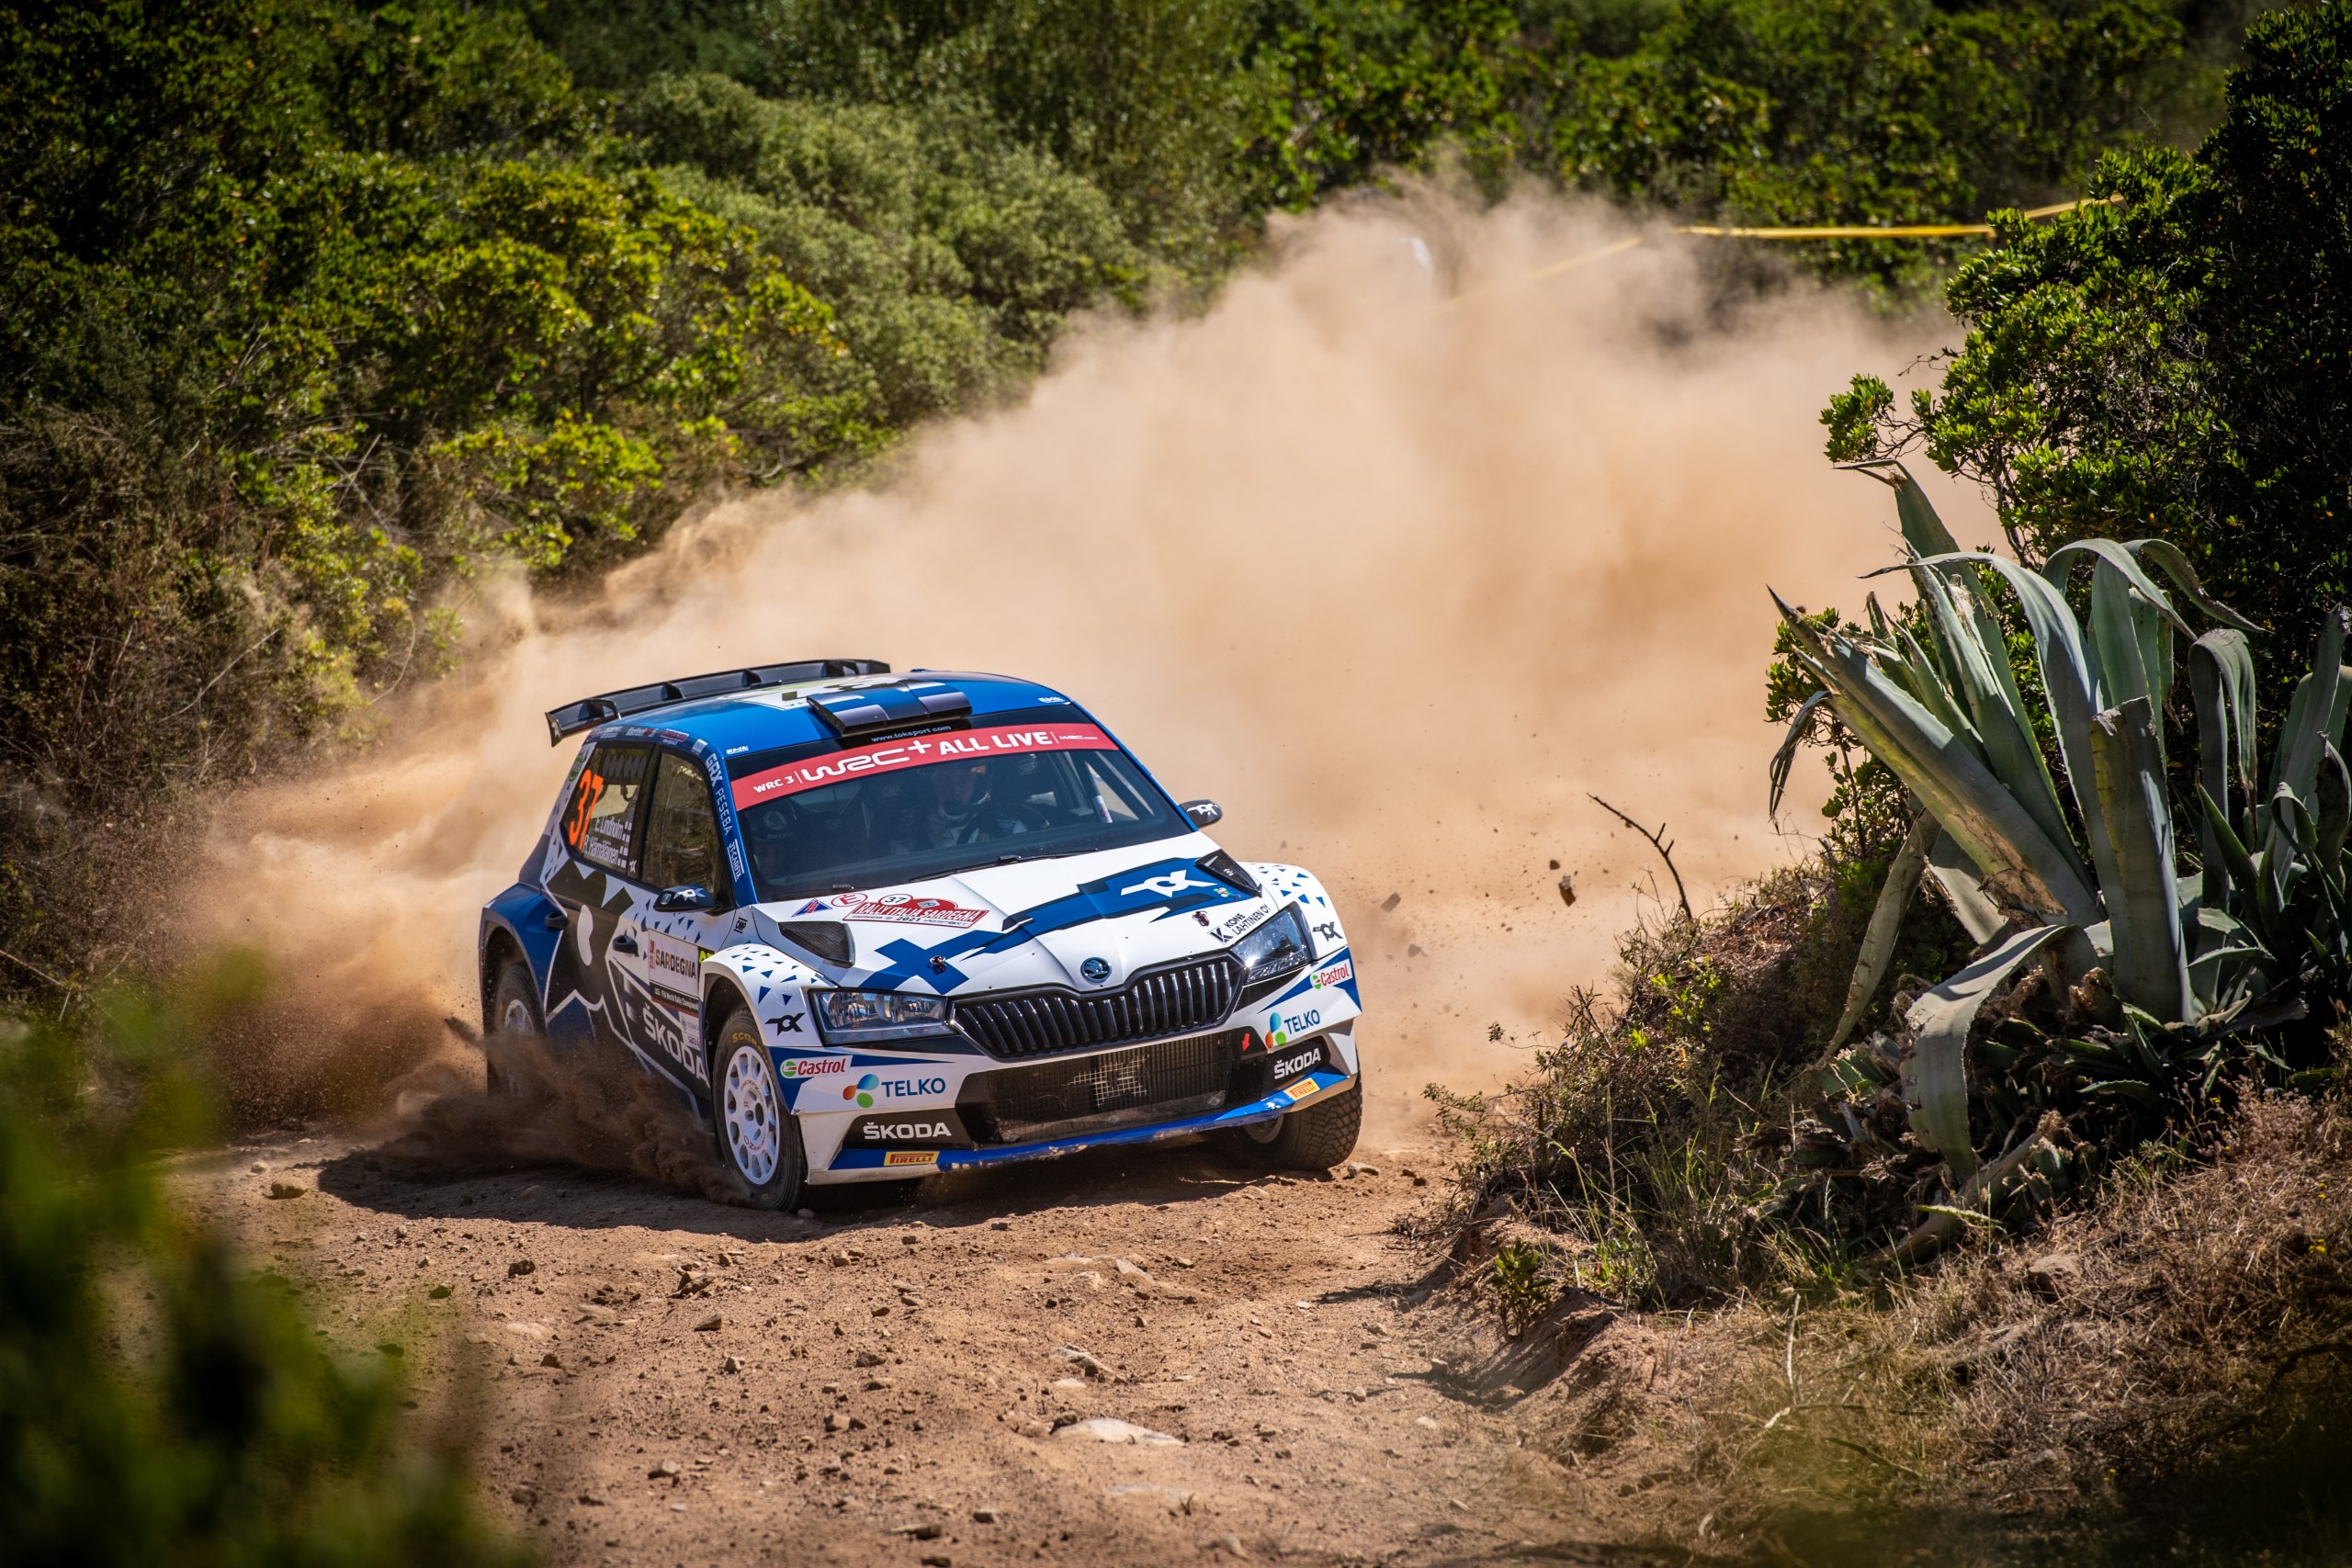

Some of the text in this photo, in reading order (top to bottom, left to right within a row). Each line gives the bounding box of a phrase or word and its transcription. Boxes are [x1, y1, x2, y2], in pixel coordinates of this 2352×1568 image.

[871, 726, 952, 742] www.toksportcom
[753, 779, 784, 793] WRC
[785, 775, 795, 784] 3
[939, 738, 990, 755] ALL
[991, 732, 1054, 749] LIVE
[706, 753, 733, 836] GRX PESEBA
[569, 769, 604, 851] 37
[858, 902, 890, 915] RALLY
[888, 906, 921, 918] ITALIA
[921, 909, 982, 922] SARDEGNA
[1224, 913, 1246, 928] KONE
[1232, 903, 1271, 935] LAHTINEN OY
[656, 948, 696, 979] SARDEGNA
[1320, 964, 1350, 987] Castrol
[1283, 1010, 1320, 1034] TELKO
[644, 1004, 711, 1089] ŠKODA
[797, 1058, 846, 1076] Castrol
[1273, 1048, 1321, 1079] ŠKODA
[881, 1077, 946, 1098] TELKO
[1289, 1081, 1316, 1098] PIRELLI
[863, 1122, 952, 1140] ŠKODA
[889, 1153, 934, 1164] PIRELLI
